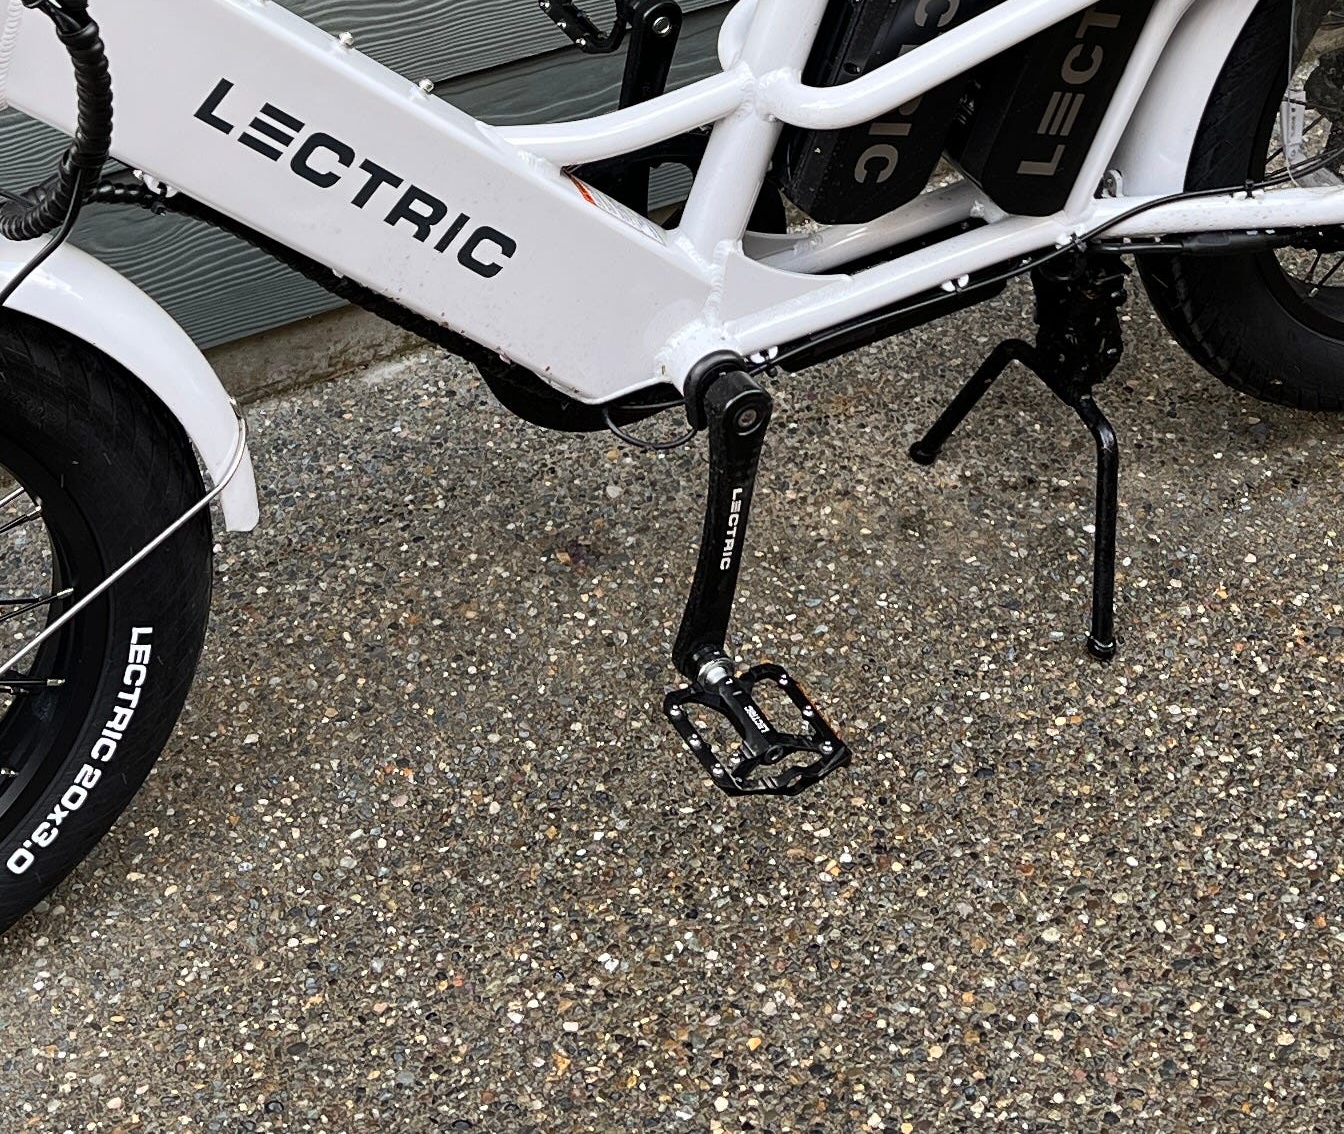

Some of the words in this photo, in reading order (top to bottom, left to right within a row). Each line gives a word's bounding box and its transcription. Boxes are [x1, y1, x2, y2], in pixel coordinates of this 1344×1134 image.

[194, 77, 517, 278] LECTRIC
[720, 487, 743, 571] LECTRIC
[90, 626, 153, 762] LECTRIC
[6, 763, 102, 874] 20x3.0
